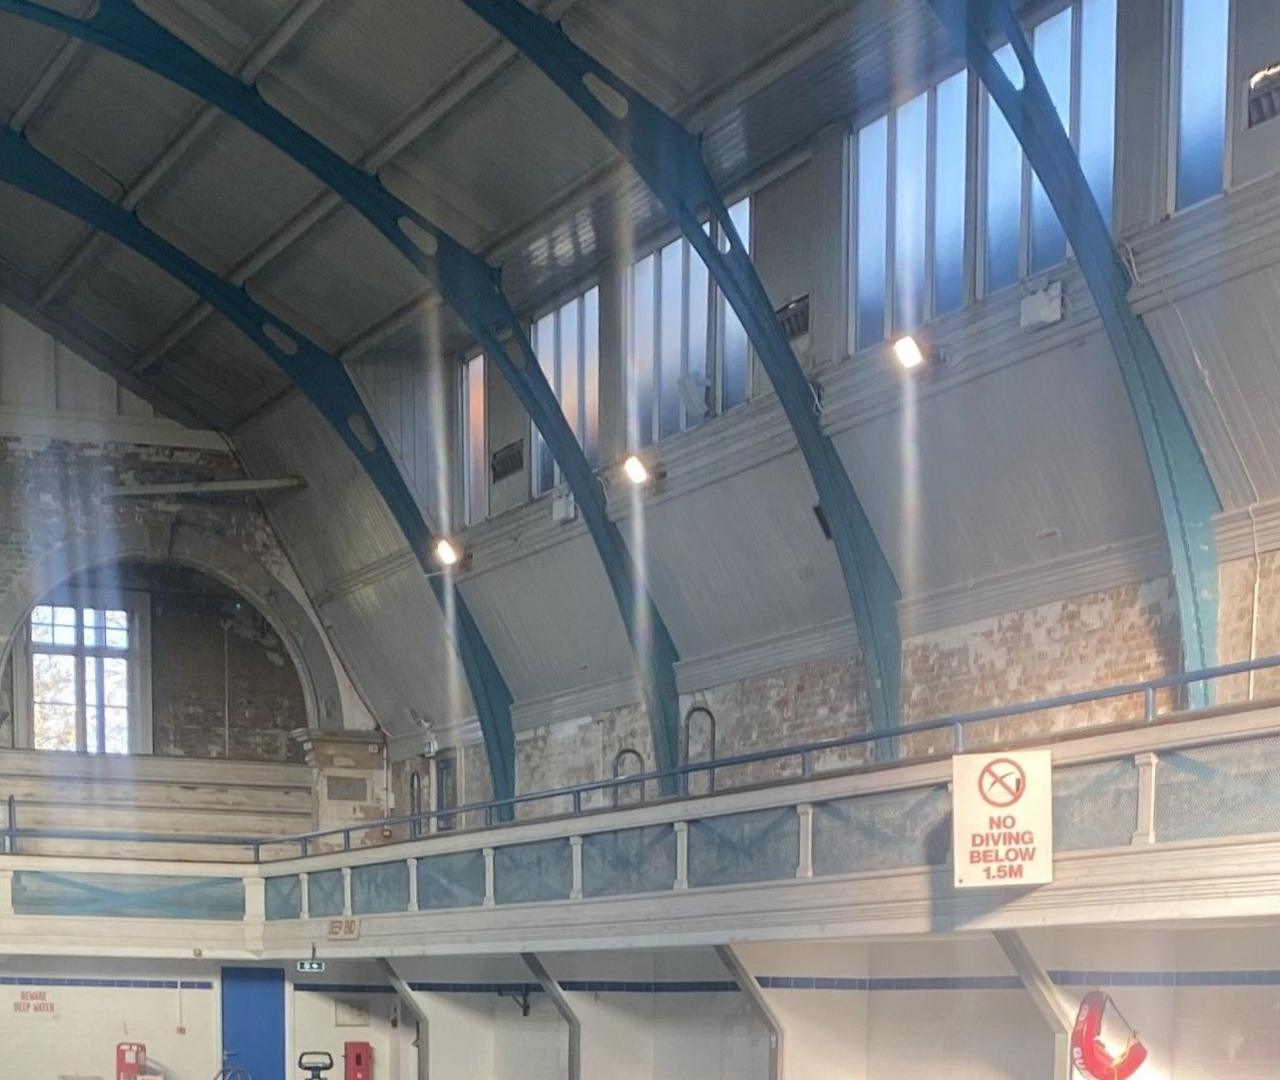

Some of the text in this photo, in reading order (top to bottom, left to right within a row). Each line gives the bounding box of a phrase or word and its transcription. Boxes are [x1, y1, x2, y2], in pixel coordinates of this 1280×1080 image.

[989, 815, 1016, 830] NO
[971, 831, 1034, 847] DIVING
[969, 847, 1036, 864] BELOW
[982, 864, 1024, 880] 1.5M
[20, 991, 47, 1001] BEWARE
[14, 1002, 55, 1013] DEEP WATER
